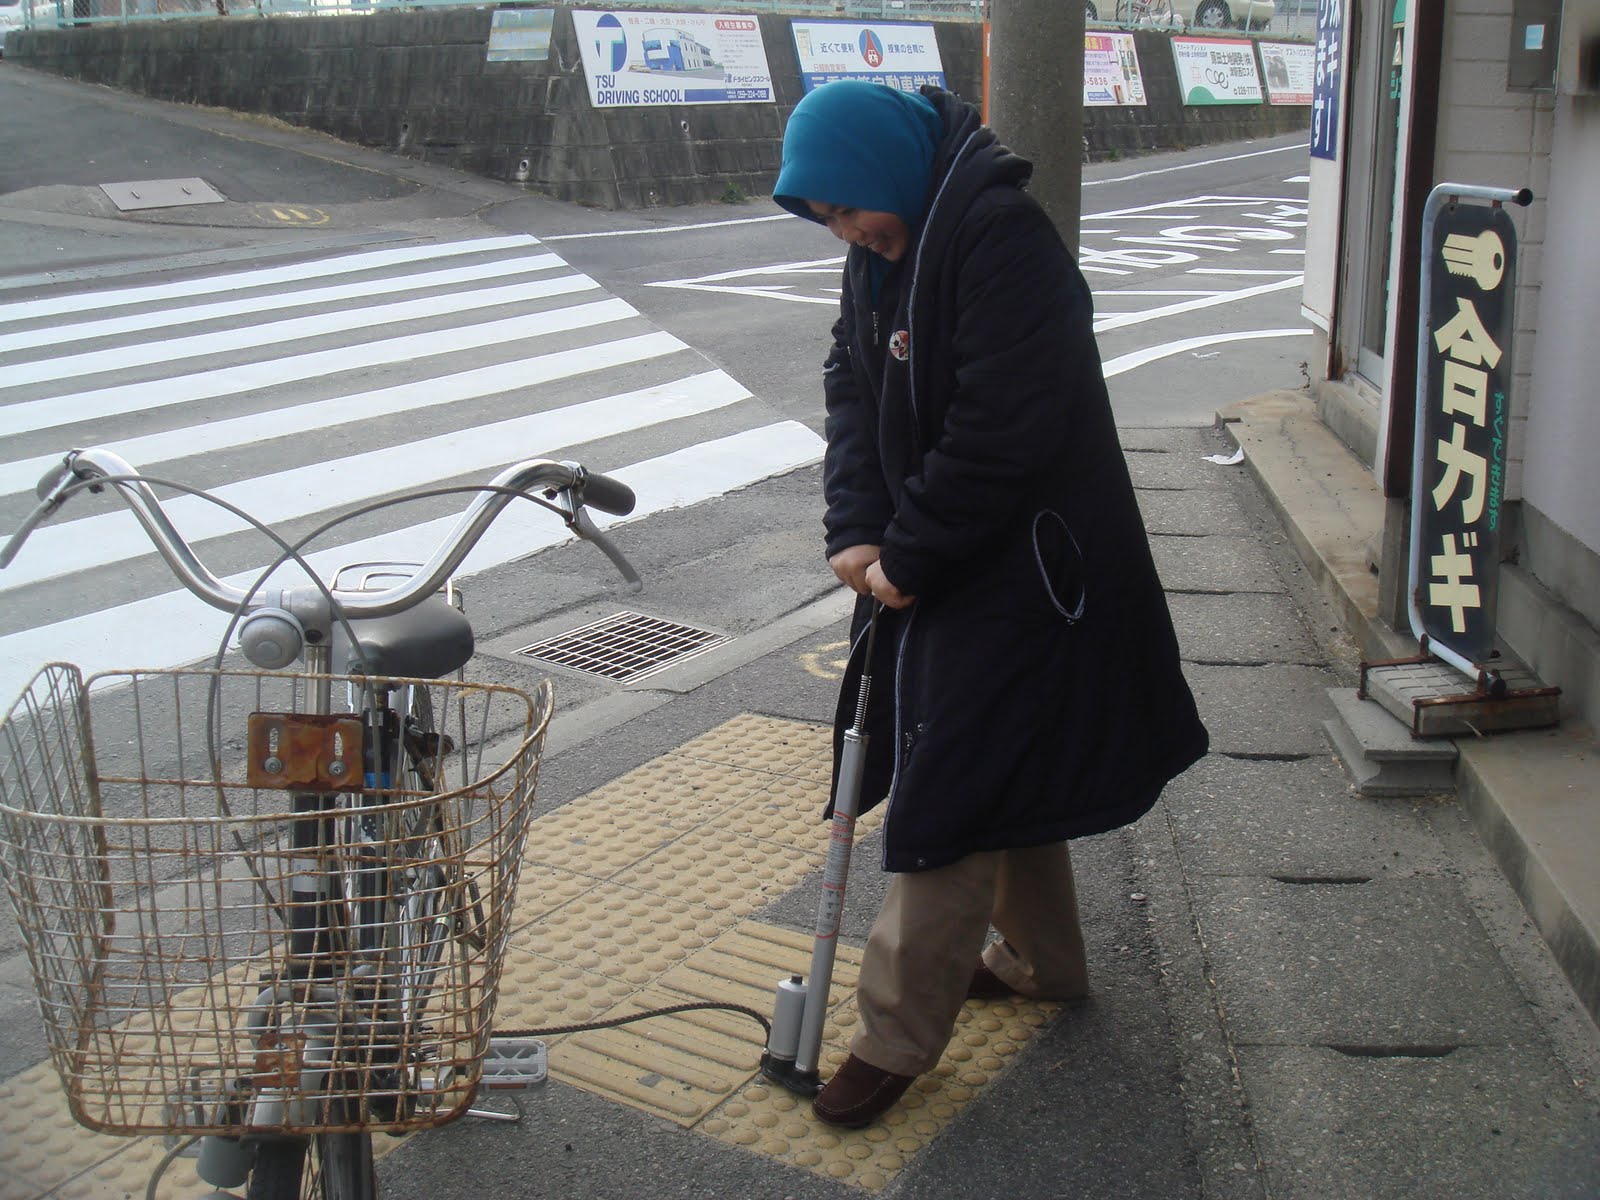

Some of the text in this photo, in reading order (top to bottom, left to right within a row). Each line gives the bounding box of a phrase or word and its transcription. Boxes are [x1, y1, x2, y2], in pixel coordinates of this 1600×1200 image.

[820, 42, 855, 53] 近くて便利
[595, 74, 616, 89] TSU
[597, 89, 683, 104] DRIVING SCHOOL
[1428, 296, 1503, 633] 合カギ
[1489, 392, 1505, 531] すぐできます
